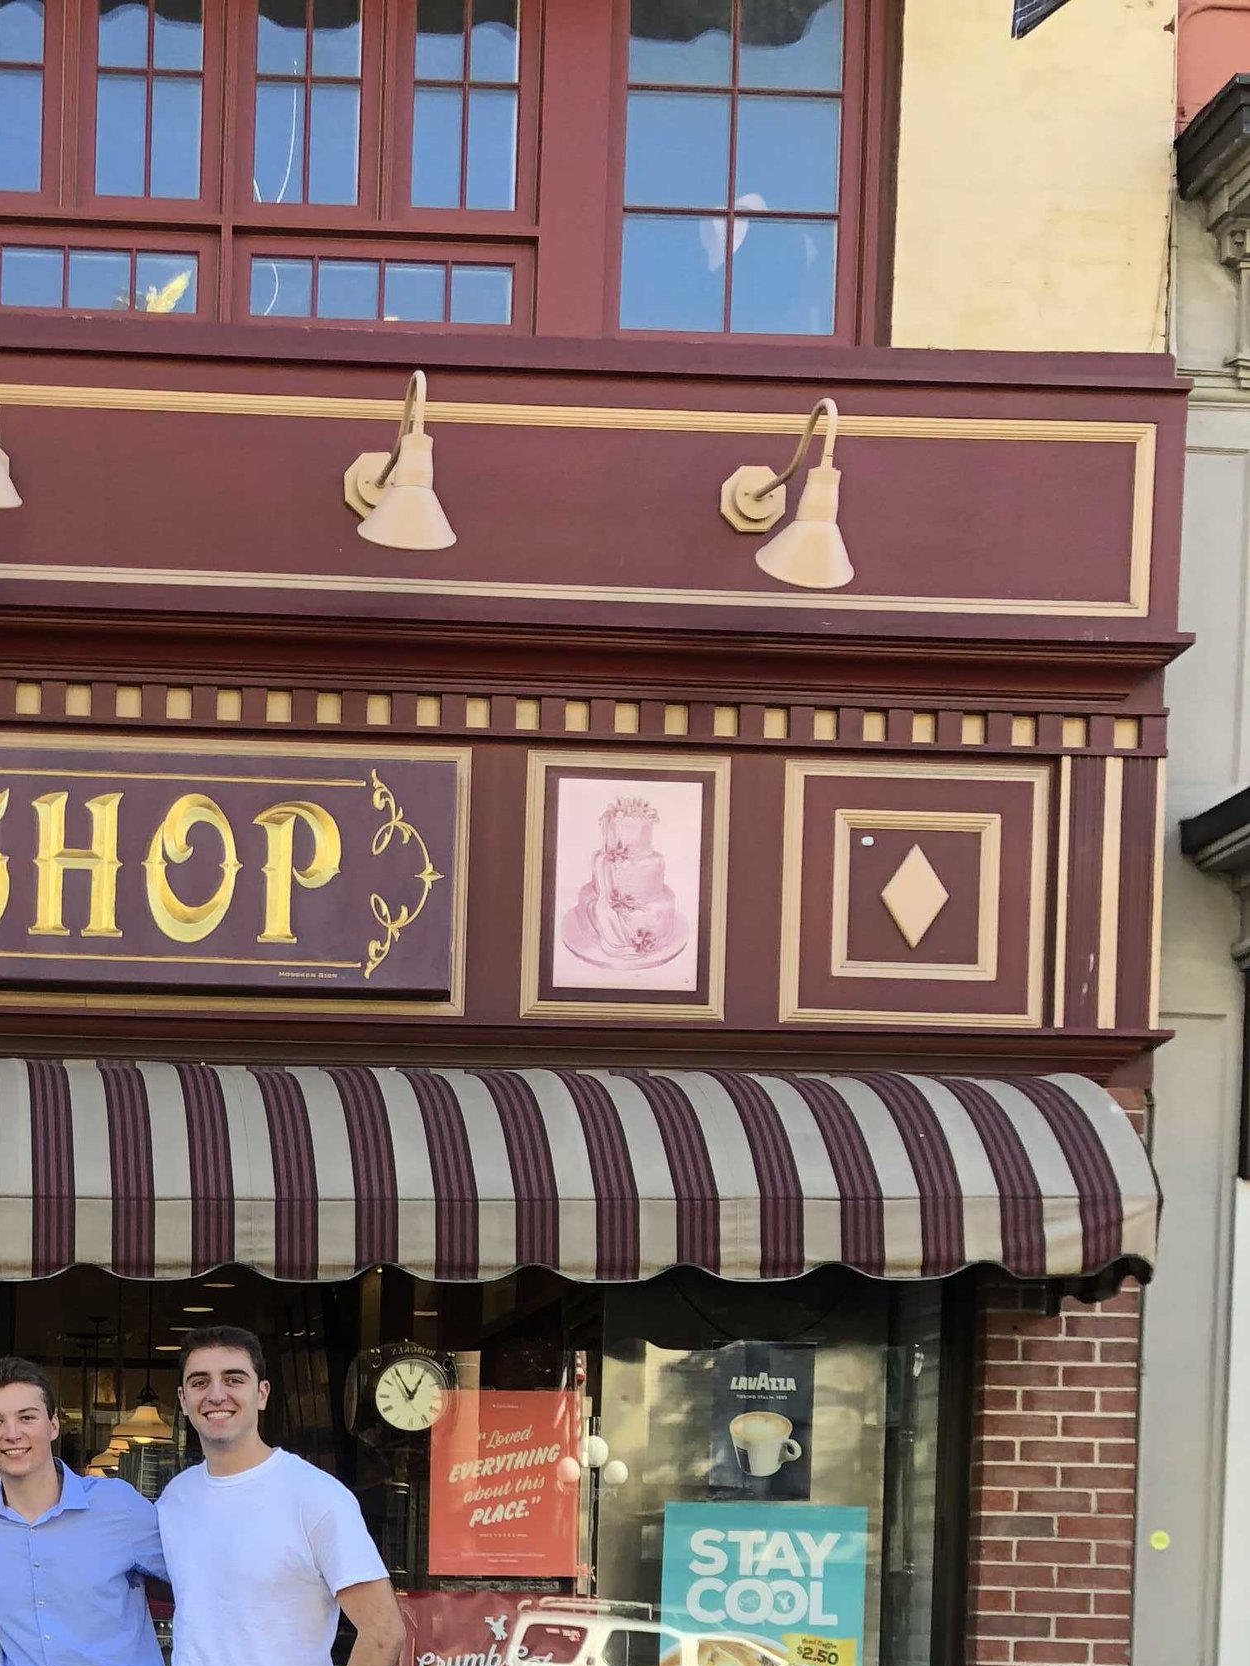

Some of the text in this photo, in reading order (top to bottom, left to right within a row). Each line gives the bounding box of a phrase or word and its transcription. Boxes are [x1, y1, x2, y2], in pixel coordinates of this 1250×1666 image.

[730, 1372, 797, 1391] LAVAZZA
[448, 1443, 561, 1483] EVERYTHING
[463, 1473, 546, 1504] about this
[688, 1528, 842, 1578] STAY
[686, 1577, 839, 1626] COOL
[797, 1645, 839, 1665] $2.50
